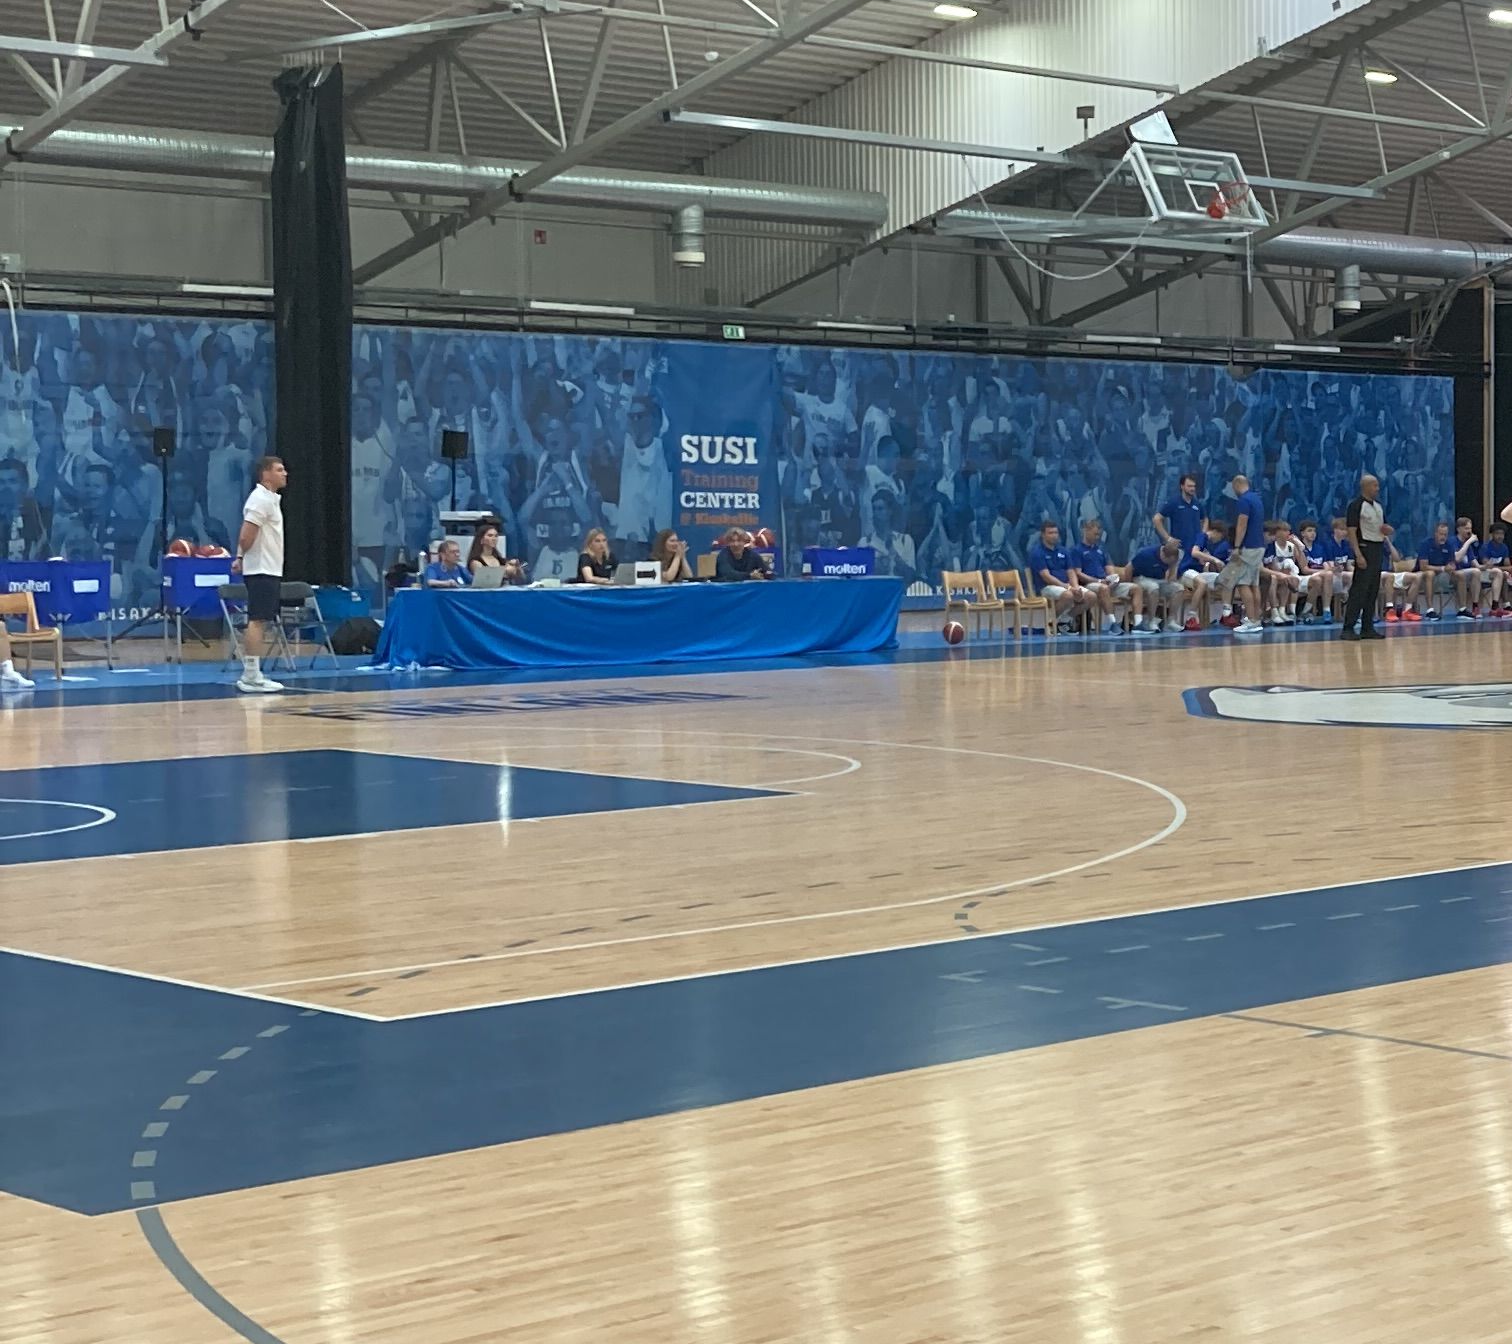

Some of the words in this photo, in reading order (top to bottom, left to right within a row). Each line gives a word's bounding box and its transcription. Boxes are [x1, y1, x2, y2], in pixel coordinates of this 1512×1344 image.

[680, 434, 758, 465] SUSI
[681, 469, 759, 491] Training
[680, 491, 760, 509] CENTER
[823, 563, 867, 574] molten
[8, 579, 50, 593] molten
